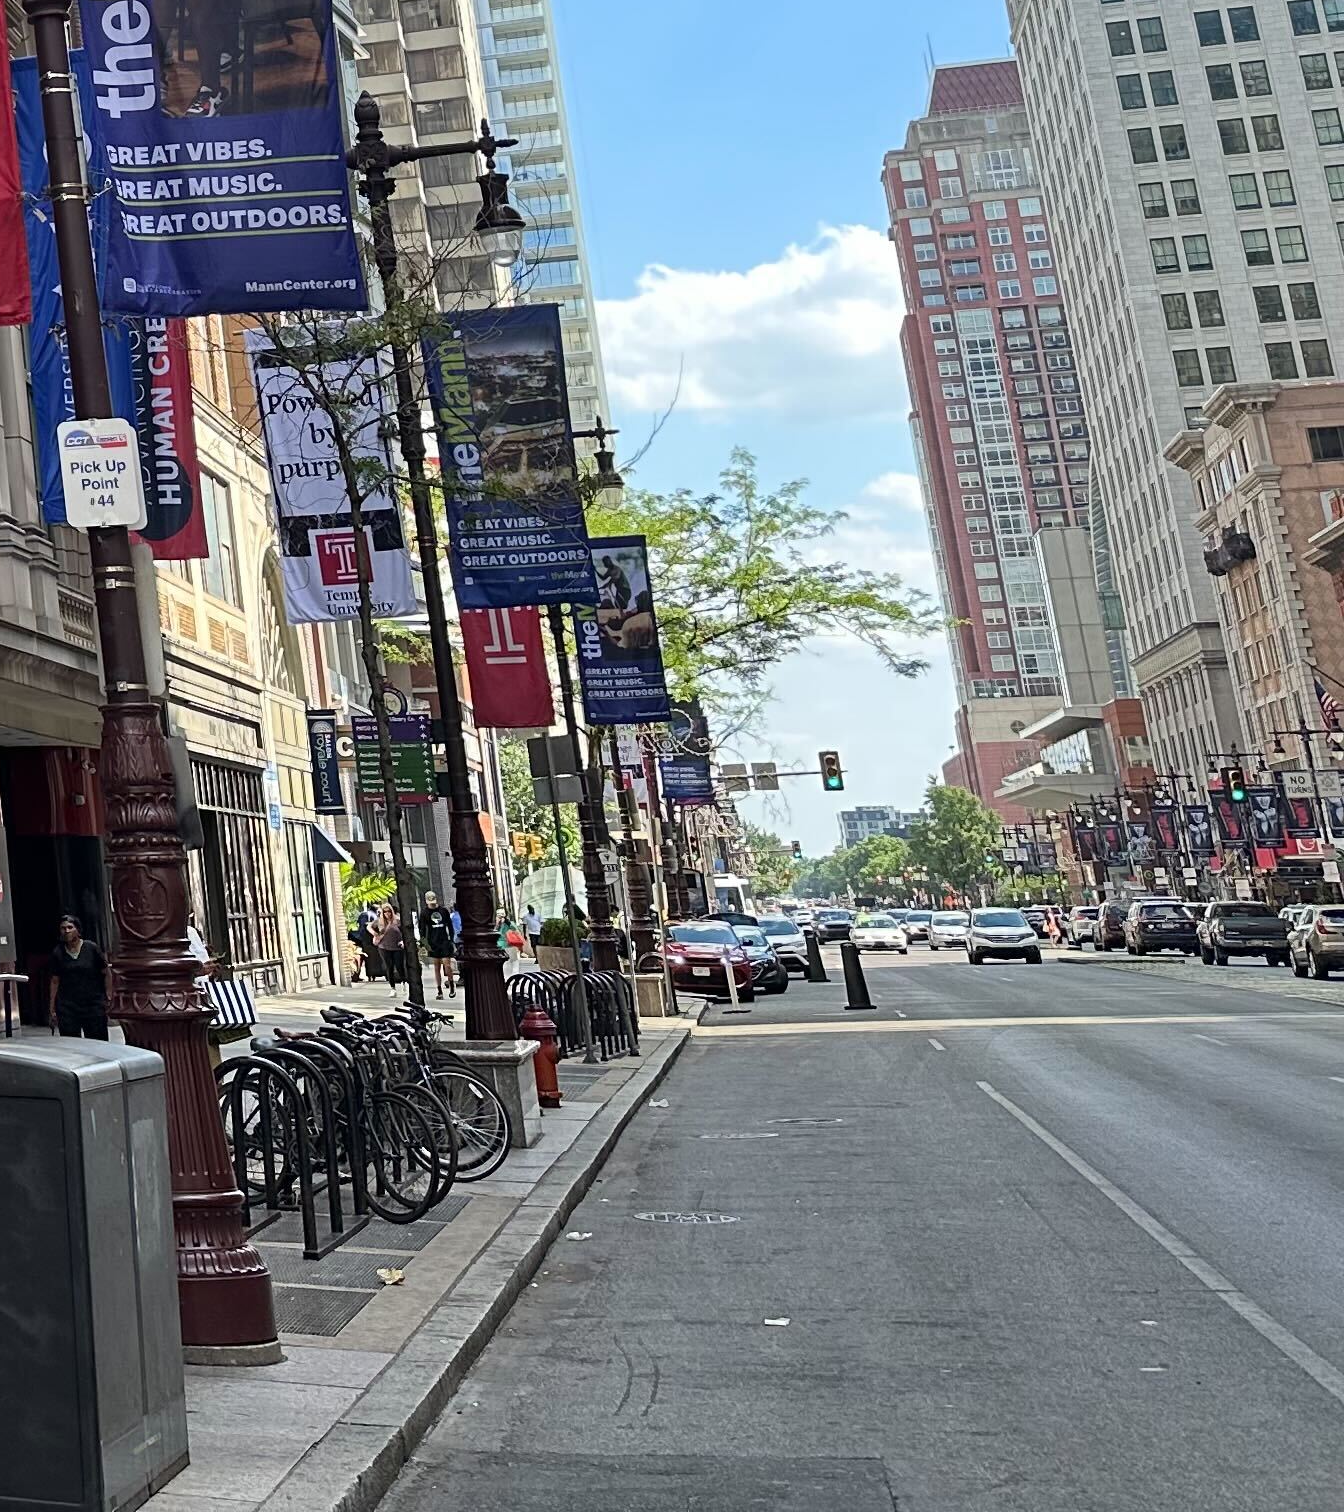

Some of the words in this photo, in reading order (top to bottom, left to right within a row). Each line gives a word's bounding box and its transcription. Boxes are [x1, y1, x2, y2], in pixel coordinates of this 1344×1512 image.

[106, 143, 181, 165] GREAT
[186, 138, 272, 161] VIBES.
[188, 172, 282, 197] MUSIC.
[191, 204, 348, 231] OUTDOORS.
[245, 278, 356, 292] MannCenter.org
[266, 385, 376, 414] Powed
[308, 422, 336, 448] by
[151, 387, 182, 504] HUMAN
[70, 461, 101, 474] Pick
[106, 460, 126, 474] Up
[81, 477, 119, 490] Point
[503, 516, 549, 529] VIBES.
[460, 536, 503, 549] GREAT
[506, 533, 555, 546] MUSIC.
[462, 554, 506, 567] GREAT
[324, 589, 372, 603] Temp
[326, 600, 394, 615] Univsity
[314, 734, 328, 769] royale
[325, 734, 333, 759] SALON
[320, 772, 333, 803] court
[1290, 776, 1305, 785] NO
